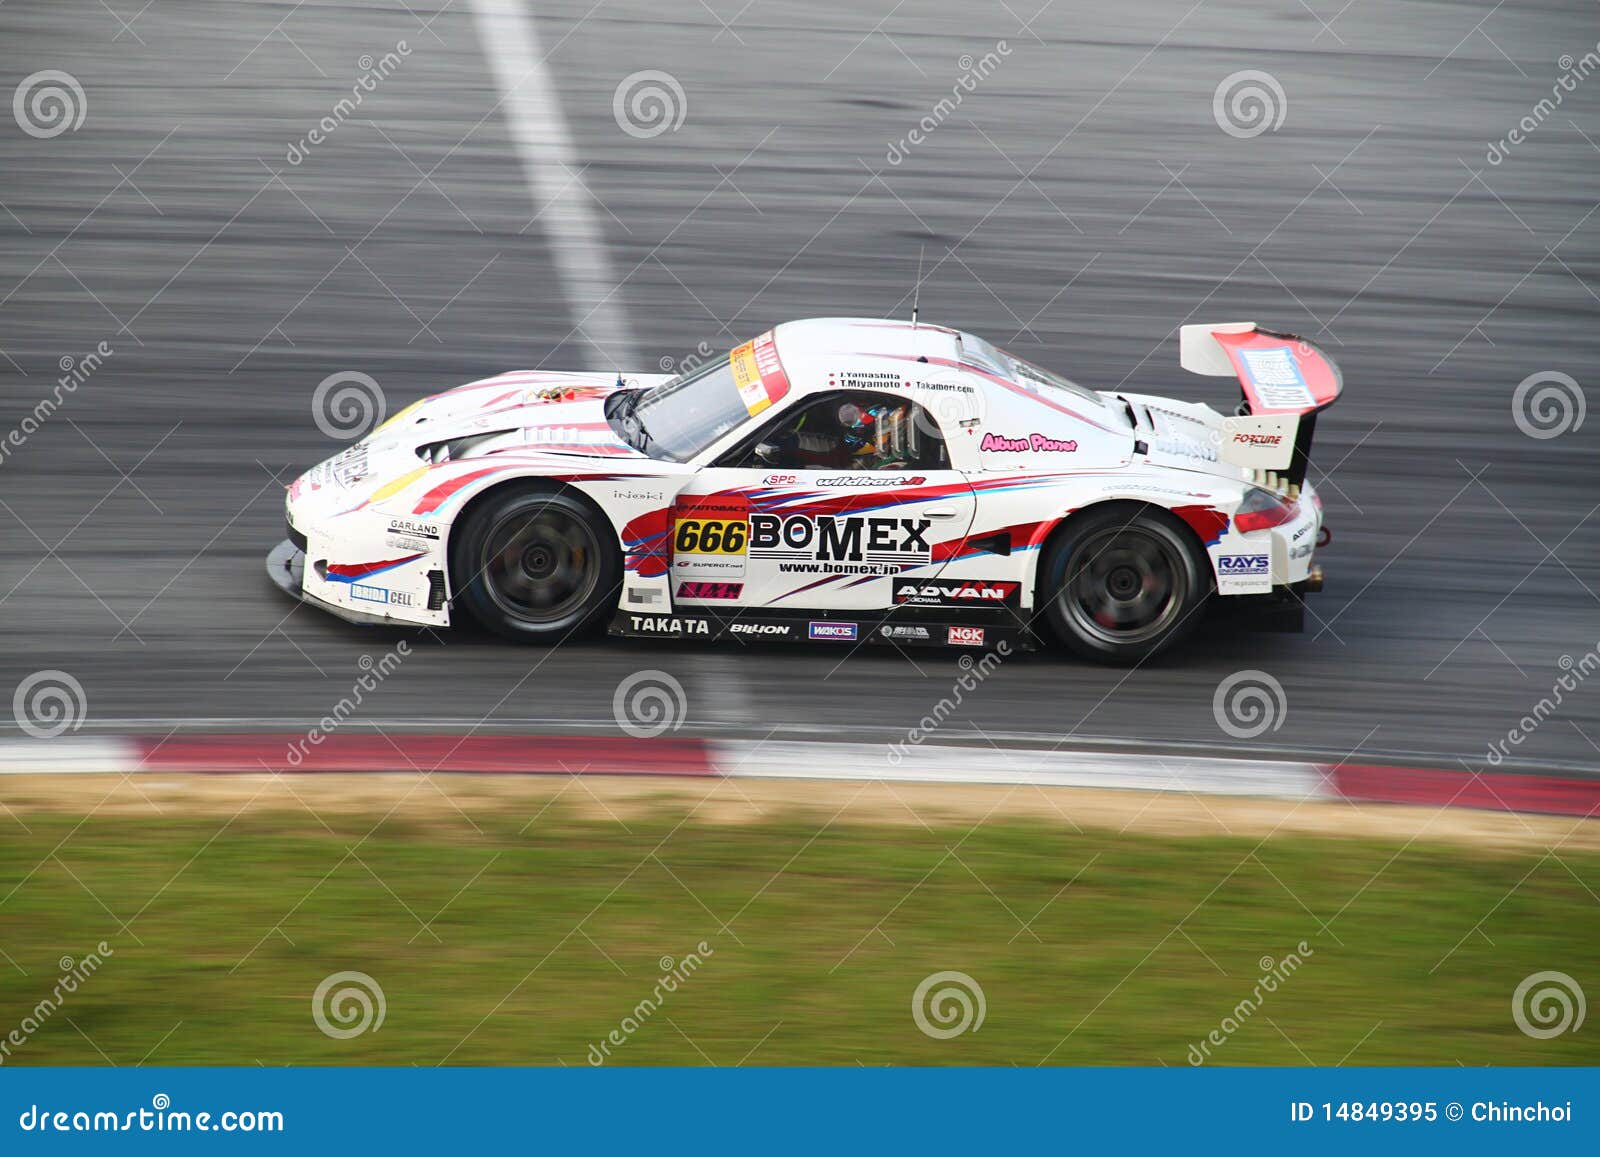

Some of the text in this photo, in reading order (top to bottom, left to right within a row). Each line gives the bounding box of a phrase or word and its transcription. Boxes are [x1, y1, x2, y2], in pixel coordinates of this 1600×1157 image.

[981, 433, 1078, 452] Album Planet
[689, 504, 746, 512] AUTOBACS
[391, 520, 438, 534] GARLAND
[675, 521, 746, 552] 666
[749, 514, 931, 561] BOMEX
[779, 563, 900, 575] www.bomex.jp
[1218, 556, 1269, 569] RAYS
[390, 591, 412, 605] CELL
[896, 586, 1004, 599] ADVAN
[630, 616, 709, 634] TAKATA
[729, 624, 790, 634] BILLION
[950, 627, 982, 640] NGK
